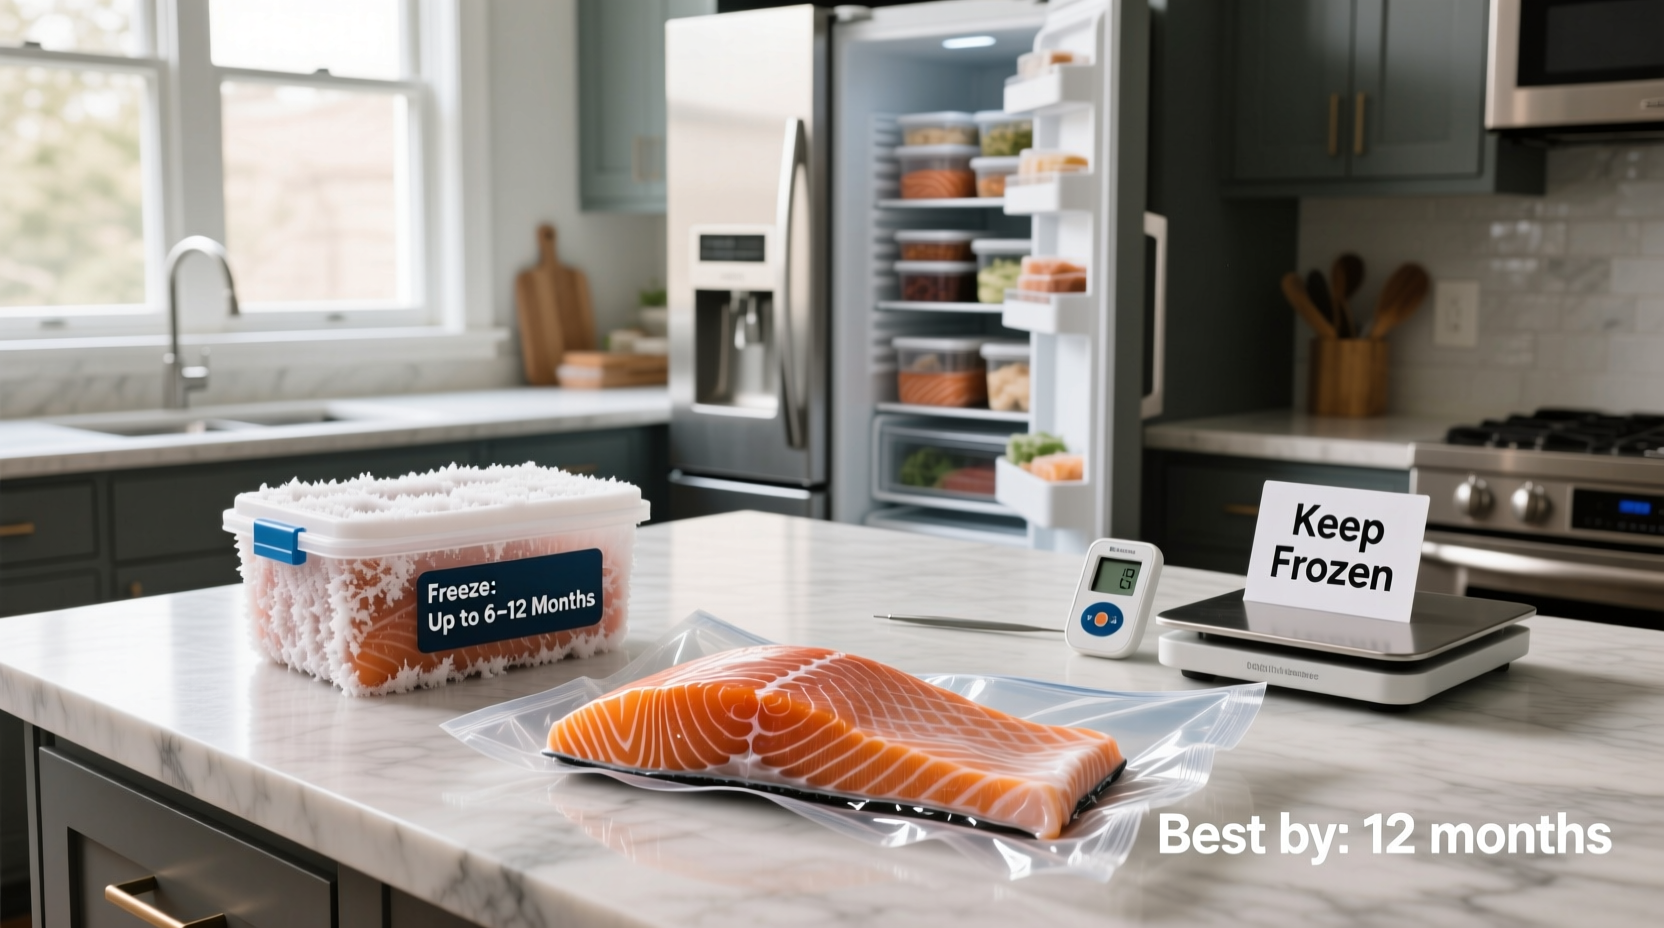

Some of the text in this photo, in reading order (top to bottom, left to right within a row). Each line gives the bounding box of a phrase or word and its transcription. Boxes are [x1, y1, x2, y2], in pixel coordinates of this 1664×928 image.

[1292, 503, 1385, 553] Keep
[1270, 544, 1393, 592] Frozen
[428, 580, 496, 604] Freeze:
[428, 611, 455, 636] Up
[459, 609, 479, 627] to
[531, 589, 596, 616] Months
